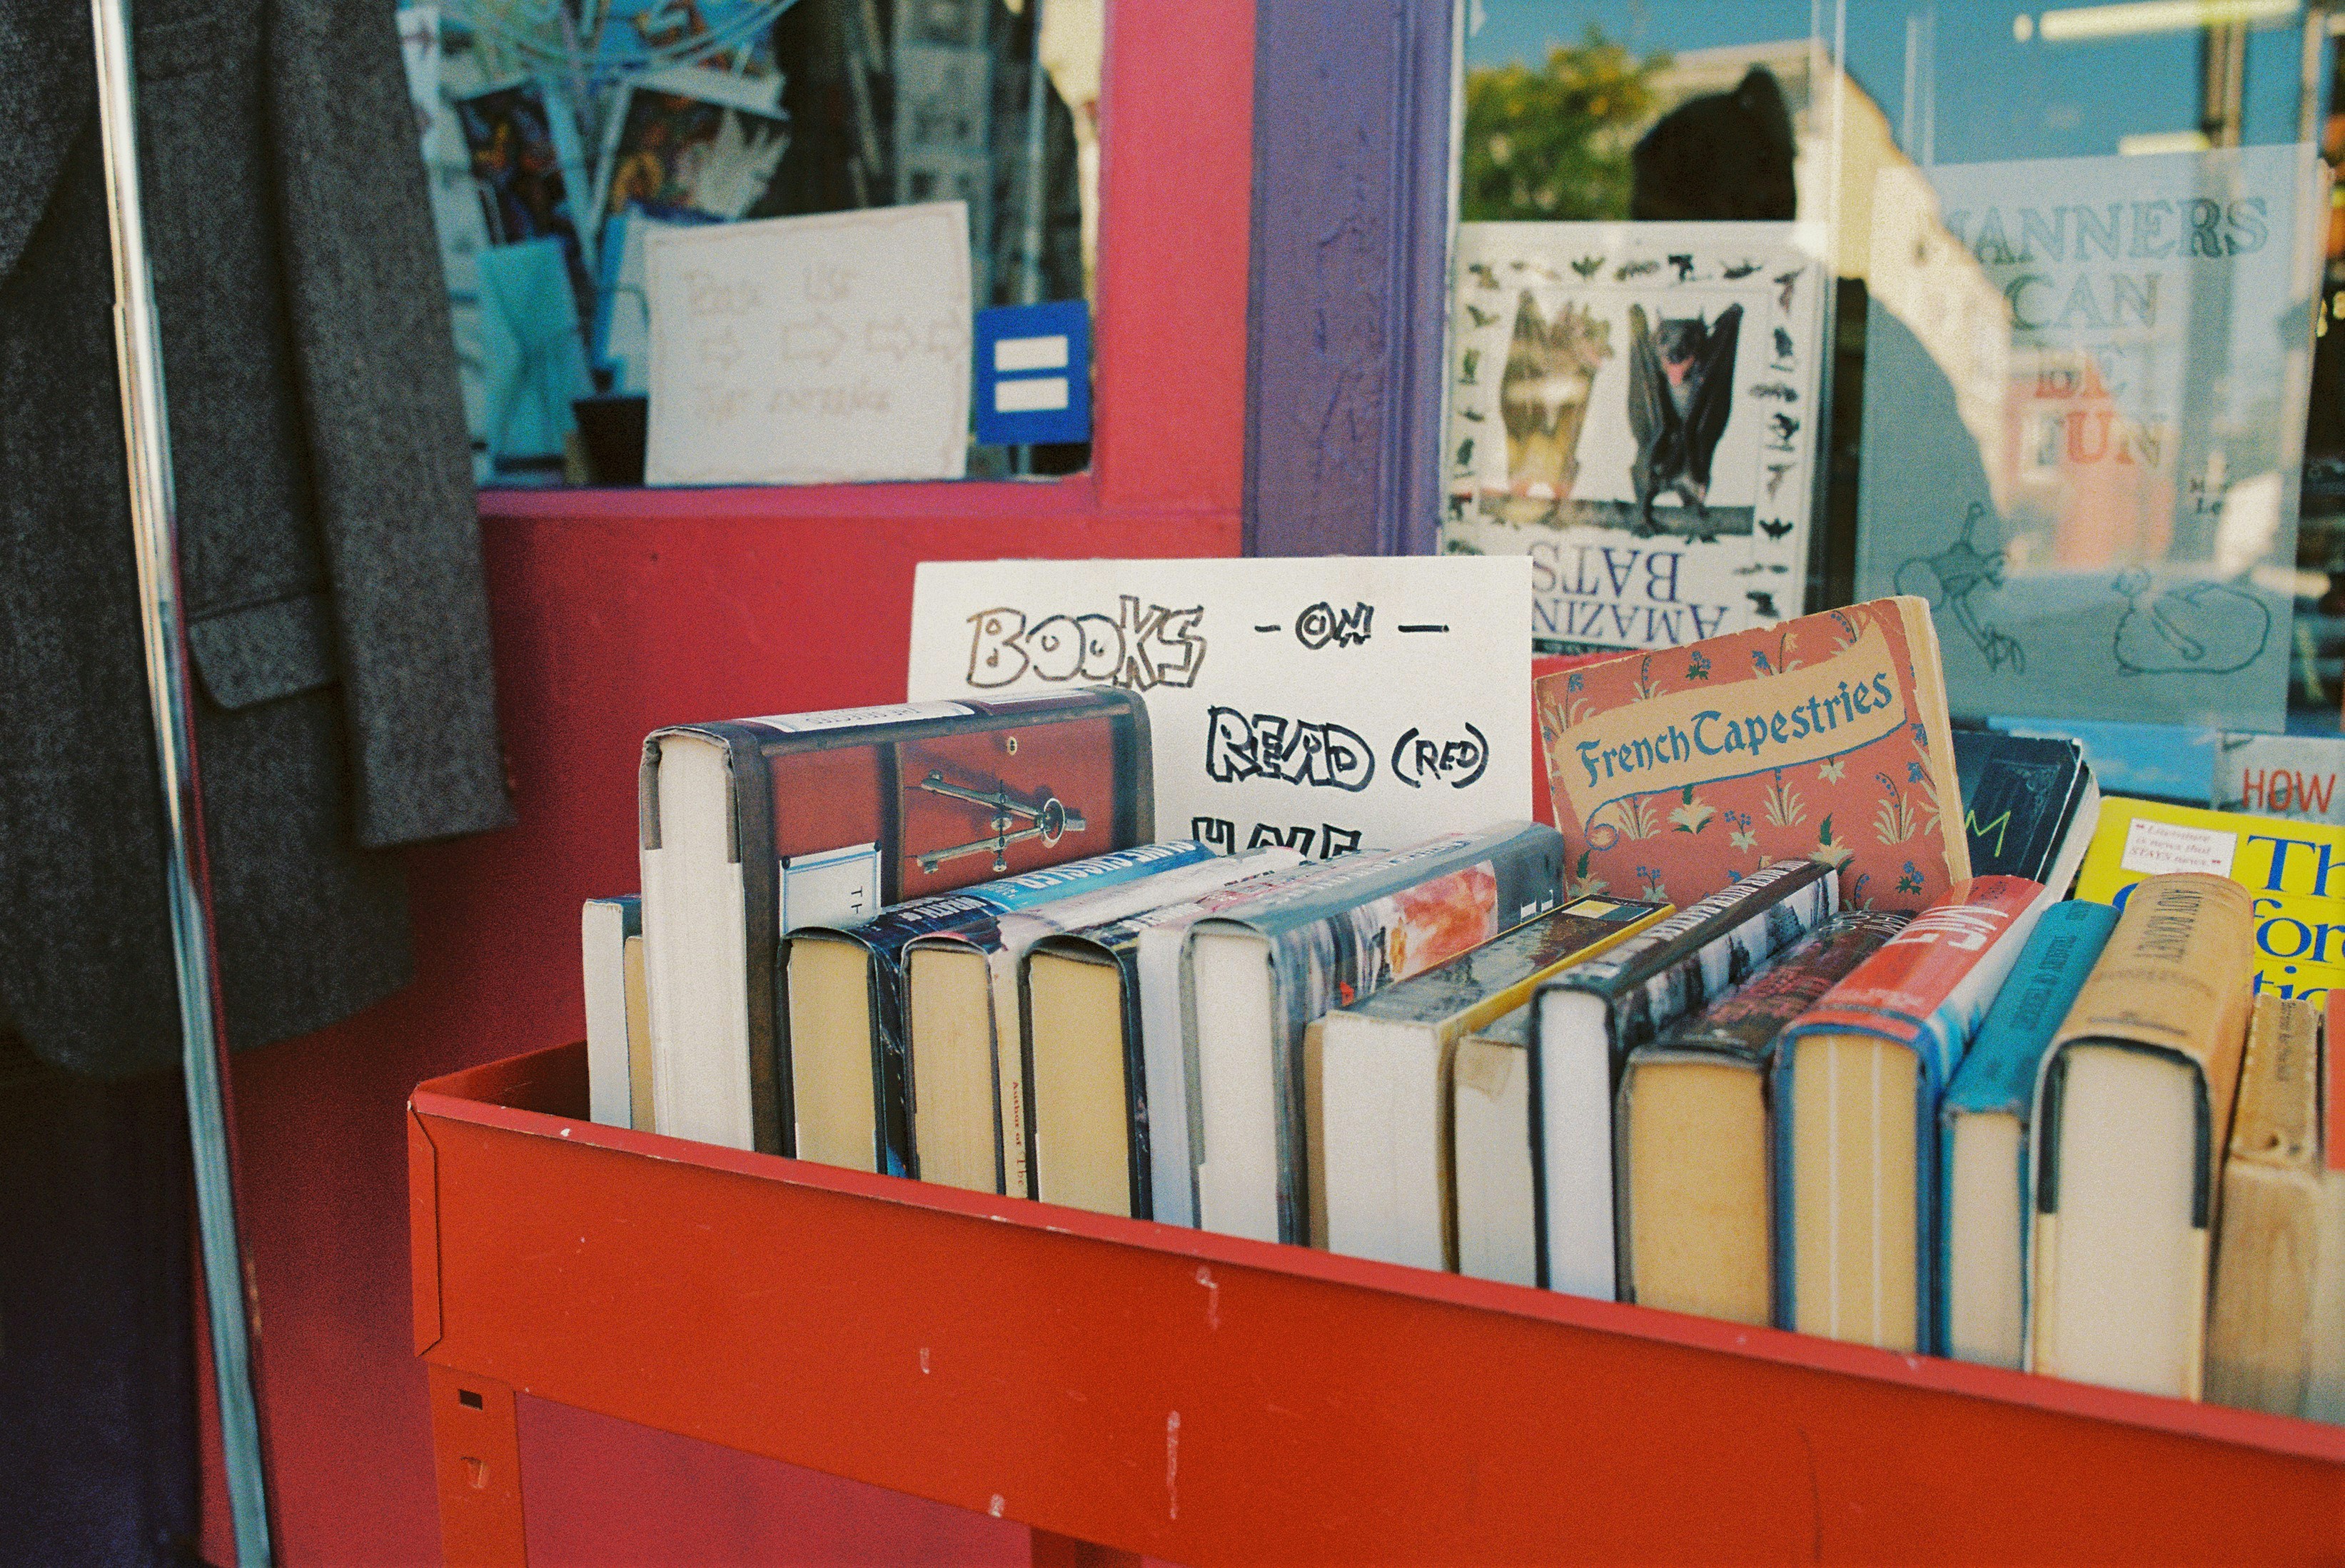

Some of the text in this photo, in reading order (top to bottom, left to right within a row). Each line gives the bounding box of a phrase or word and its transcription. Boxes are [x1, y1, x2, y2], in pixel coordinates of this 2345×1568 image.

[1945, 196, 2269, 264] ANNERS
[2004, 273, 2162, 330] CAN
[1527, 540, 1683, 603] BATS
[966, 594, 1374, 691] BOOKS ON
[1532, 598, 1728, 644] AMAZIN
[1206, 704, 1489, 792] READ (RED)
[1575, 672, 1893, 788] French Tapestries
[2242, 767, 2336, 814] HOW
[997, 841, 1196, 889] CLIVE CUSSLER
[2247, 834, 2345, 897] Th
[850, 886, 862, 914] TH
[913, 896, 988, 919] WRATH
